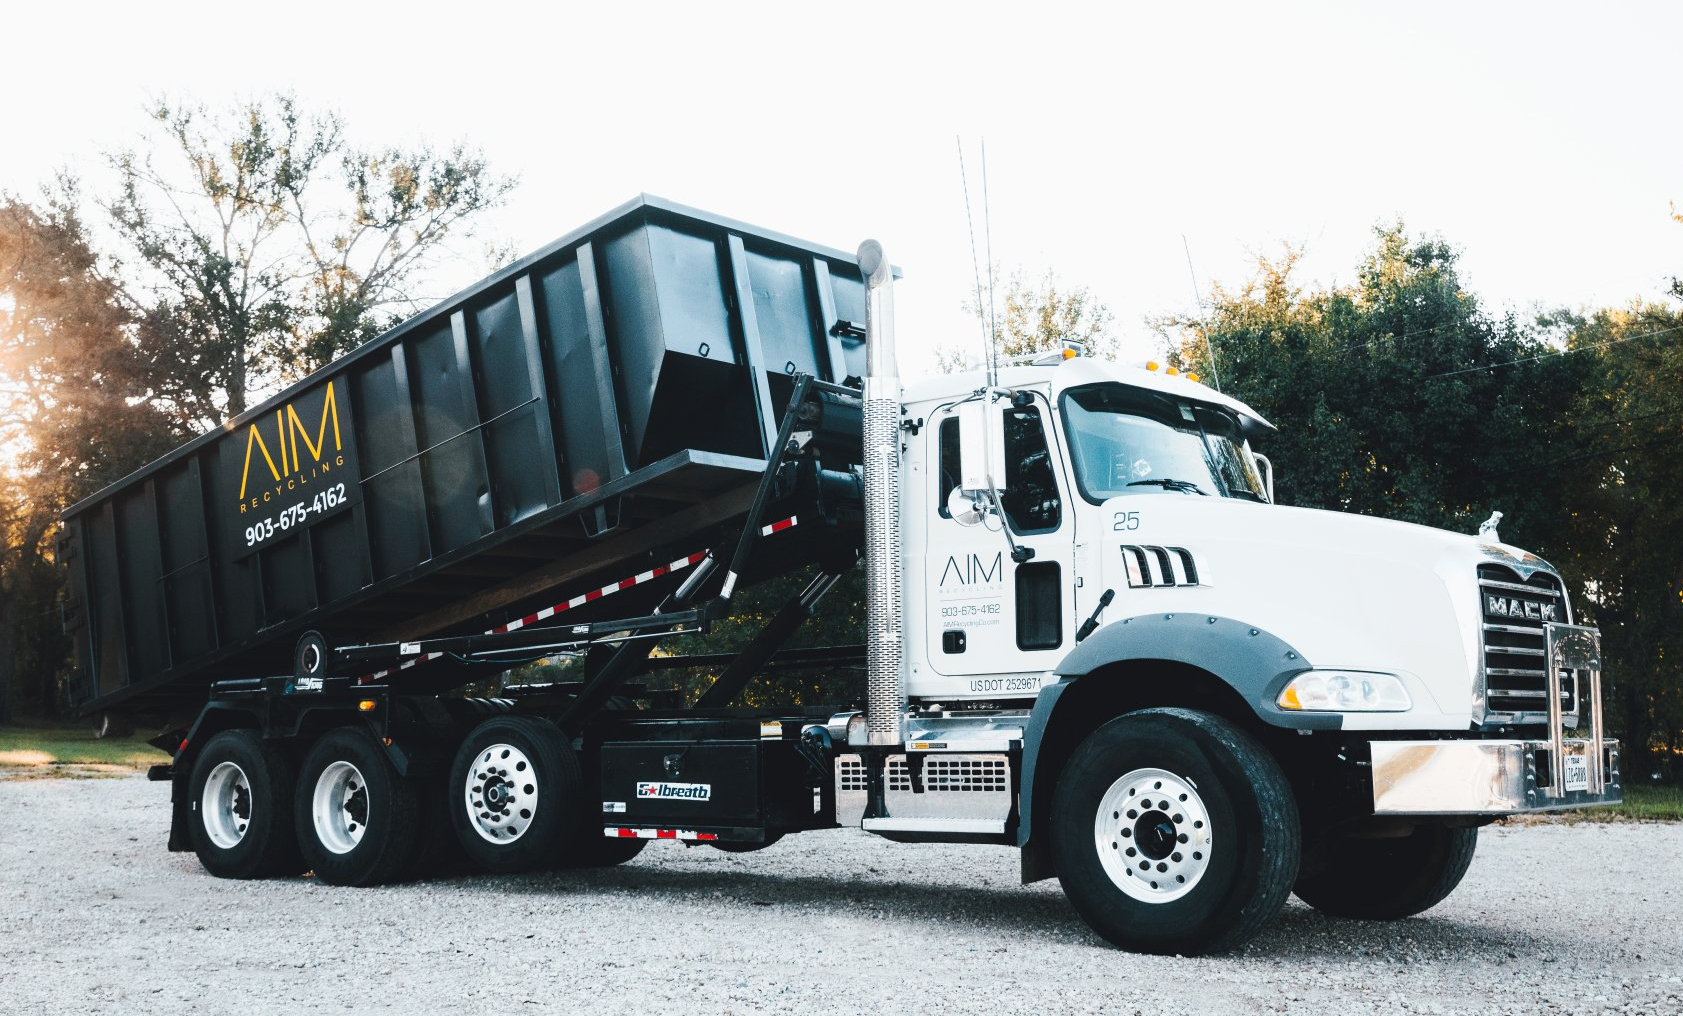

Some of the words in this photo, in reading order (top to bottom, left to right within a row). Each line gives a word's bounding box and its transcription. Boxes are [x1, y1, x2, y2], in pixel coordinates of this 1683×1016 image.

[239, 381, 342, 500] AIM
[240, 455, 344, 513] RECYCLING
[245, 483, 347, 546] 903-675-4162
[1113, 511, 1140, 531] 25
[939, 551, 1002, 586] AIM
[941, 603, 1001, 617] 903-675-4162
[1488, 596, 1557, 621] MACK
[1006, 677, 1041, 690] 2529671
